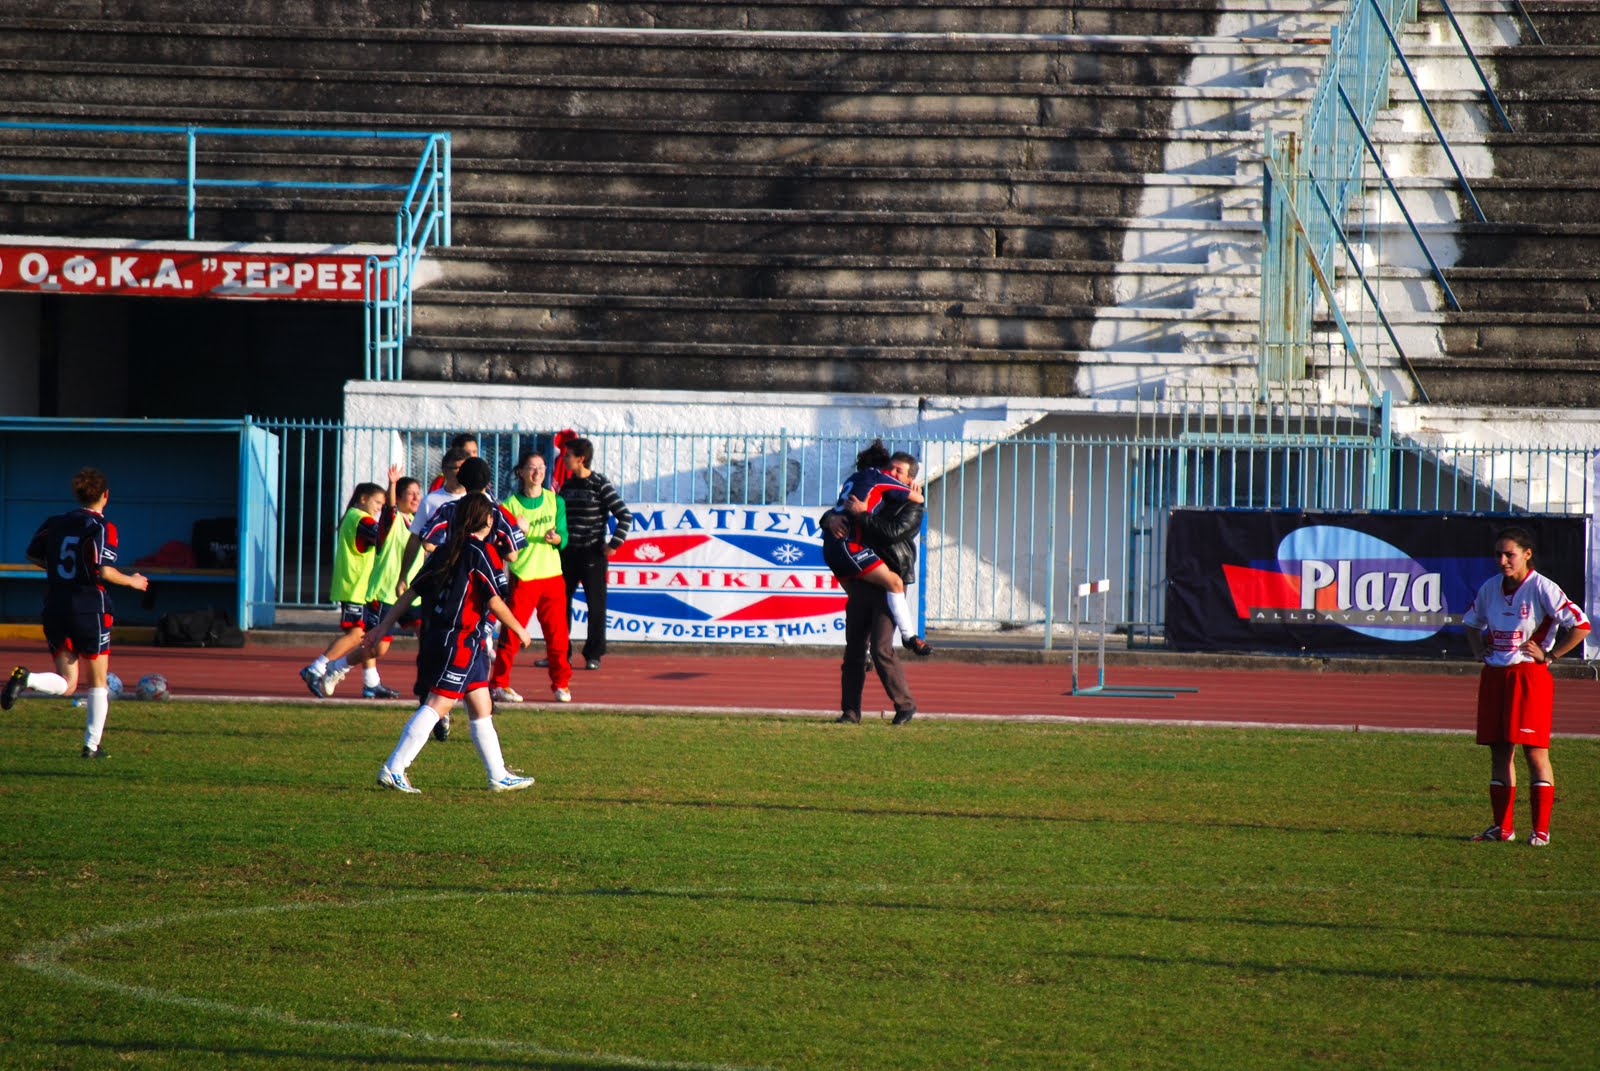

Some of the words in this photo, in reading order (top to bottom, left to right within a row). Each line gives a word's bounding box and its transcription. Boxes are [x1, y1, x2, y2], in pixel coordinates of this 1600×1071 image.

[19, 252, 193, 290] Ο.Φ.Κ.Α.
[56, 536, 80, 580] 5
[1301, 559, 1443, 613] Plaza
[662, 622, 769, 638] 70-ΣΕΡΡΕΣ
[775, 622, 827, 638] ΤΗΛ.:
[1366, 614, 1428, 623] CAFE
